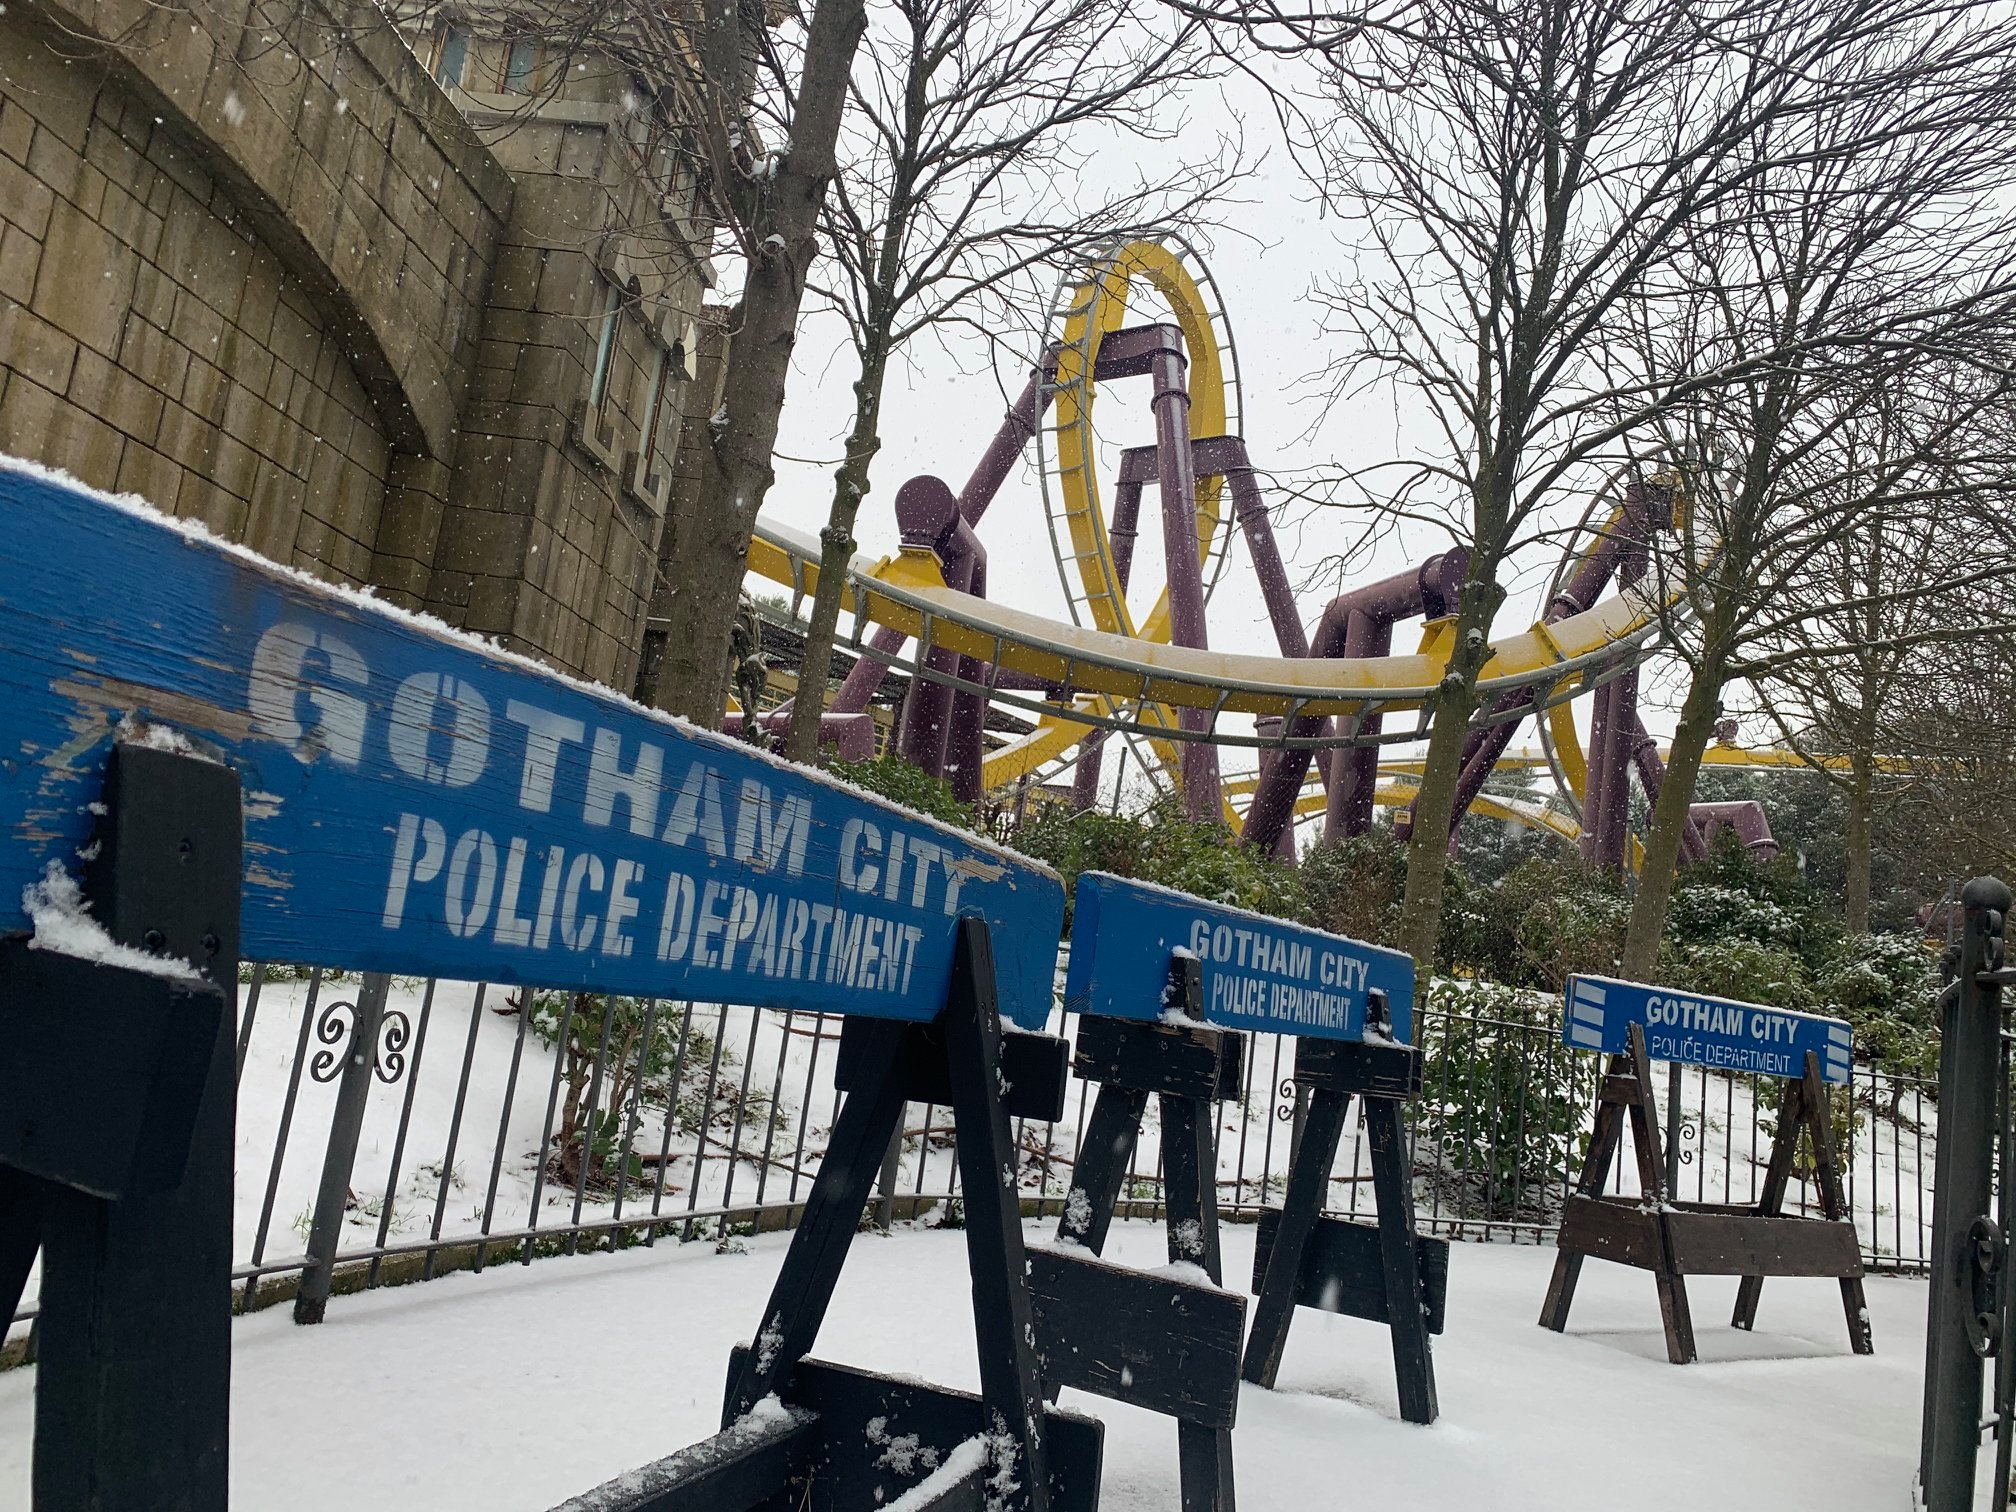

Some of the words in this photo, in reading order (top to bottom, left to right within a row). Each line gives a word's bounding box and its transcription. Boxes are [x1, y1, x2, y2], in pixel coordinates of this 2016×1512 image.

[248, 623, 811, 876] GOTHAM
[840, 818, 968, 915] CITY
[381, 812, 644, 957] POLICE
[656, 871, 924, 996] DEPARTMENT
[1189, 919, 1313, 981] GOTHAM
[1320, 950, 1370, 992] CITY
[1211, 972, 1267, 1018] POLICE
[1270, 982, 1350, 1030] DEPARTMENT
[1646, 996, 1743, 1036] GOTHAM
[1752, 1014, 1799, 1043] CITY
[1653, 1036, 1702, 1061] POLICE
[1705, 1043, 1791, 1073] DEPARTMENT
